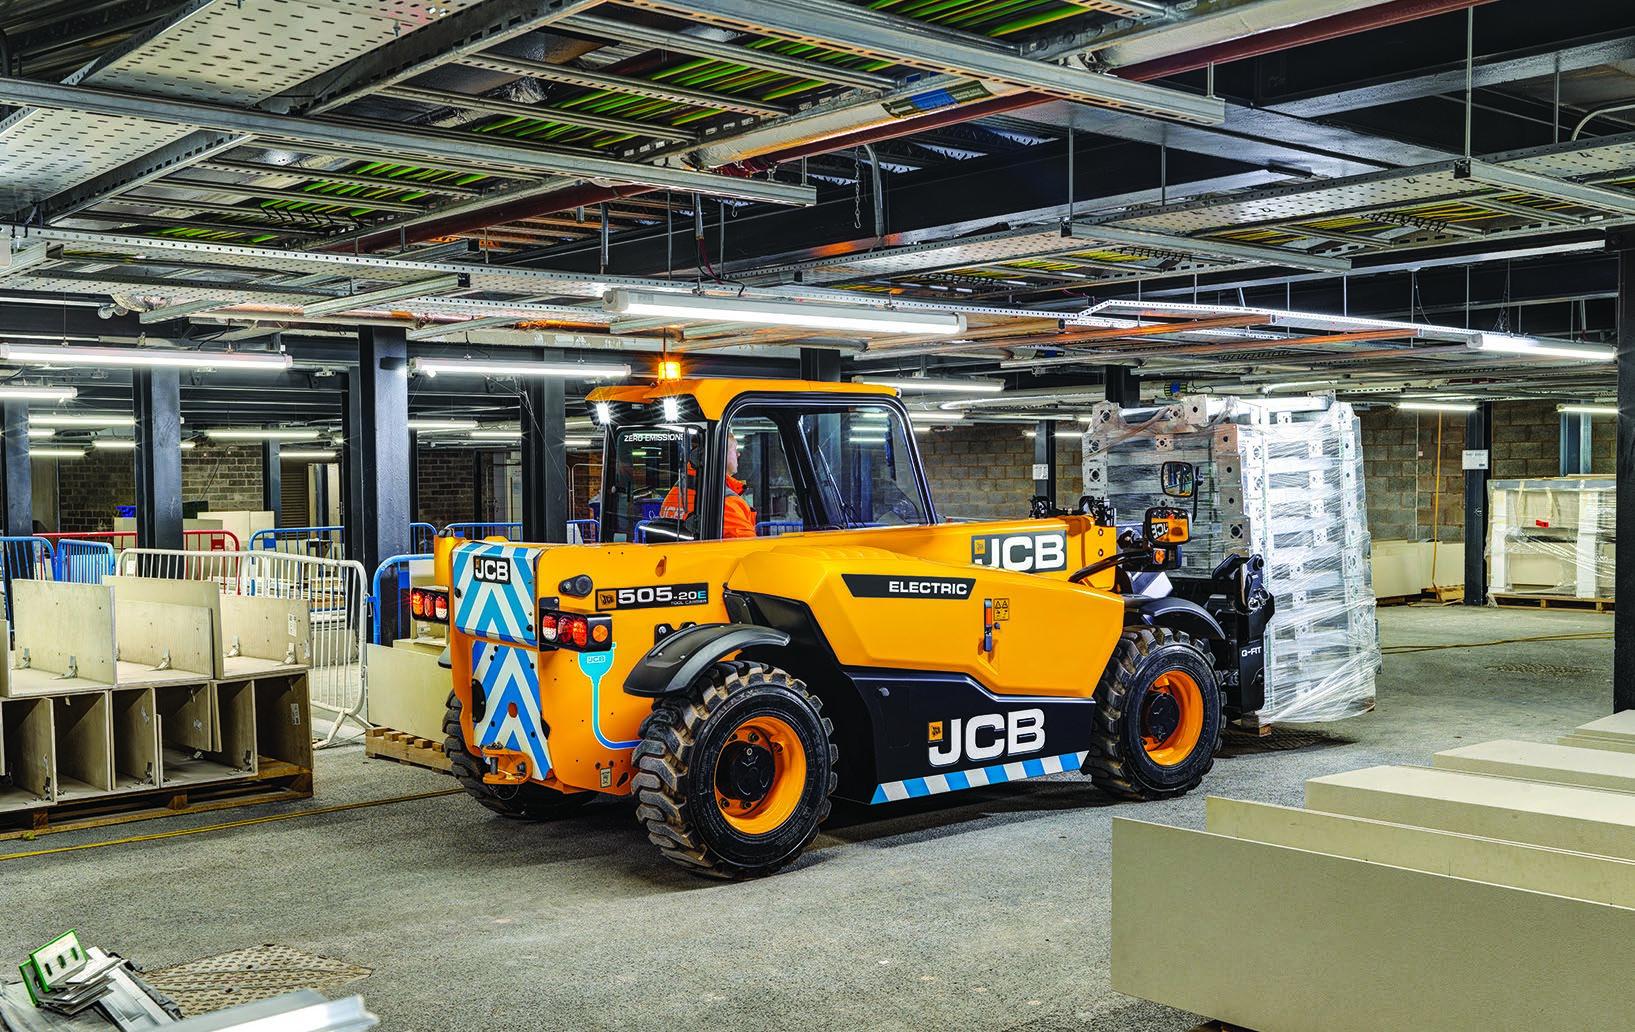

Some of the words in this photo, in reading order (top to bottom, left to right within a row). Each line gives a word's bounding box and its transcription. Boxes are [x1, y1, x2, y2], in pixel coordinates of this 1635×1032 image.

[624, 434, 643, 442] ZERO
[974, 534, 1065, 572] JCB
[475, 559, 508, 581] JCB
[889, 581, 967, 595] ELECTRIC
[928, 708, 1046, 767] JCB
